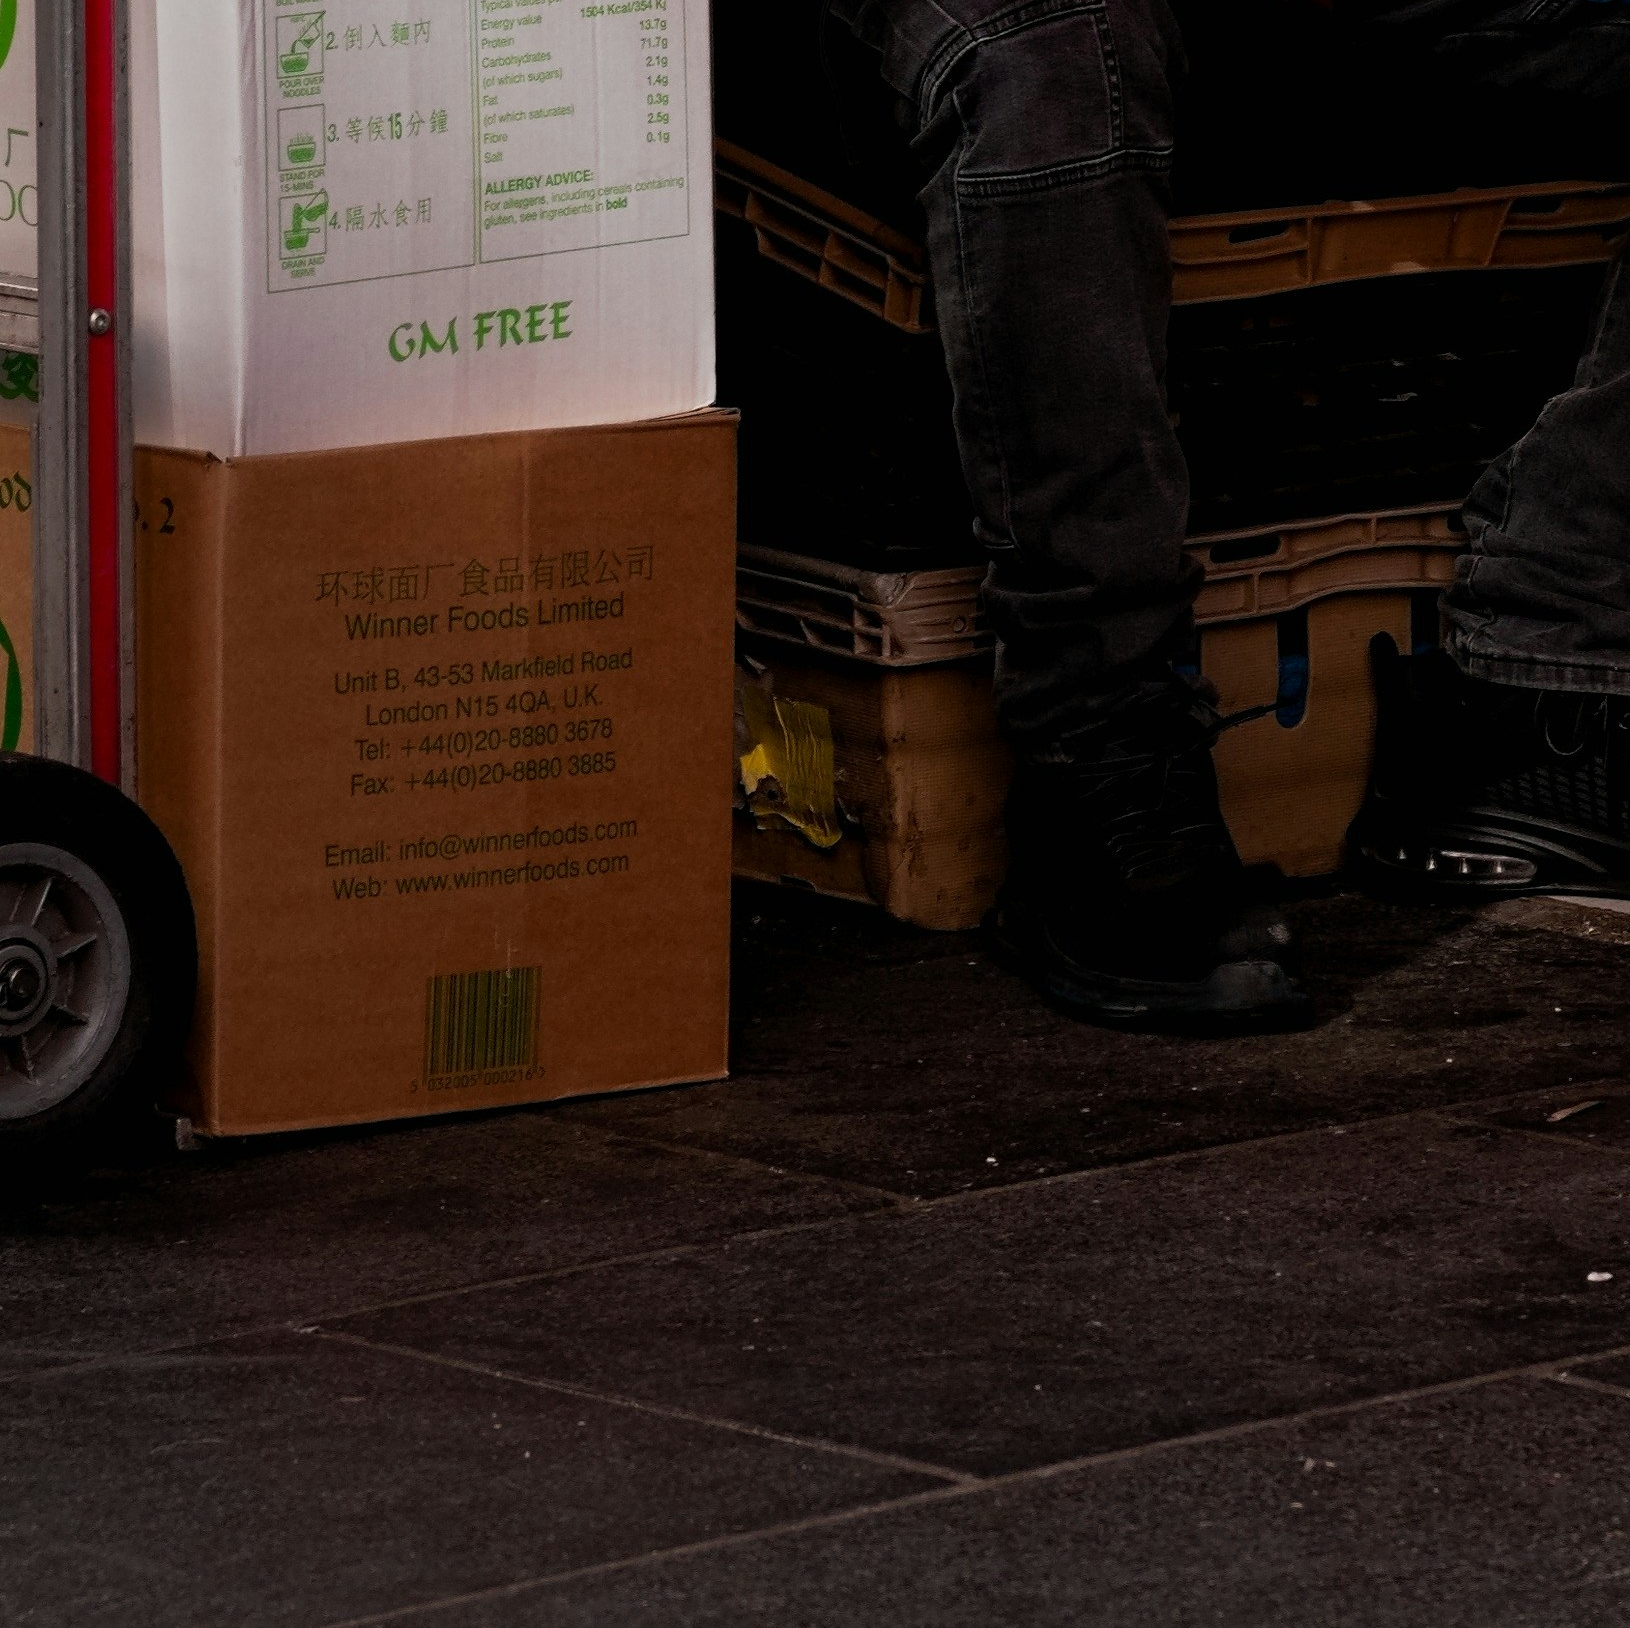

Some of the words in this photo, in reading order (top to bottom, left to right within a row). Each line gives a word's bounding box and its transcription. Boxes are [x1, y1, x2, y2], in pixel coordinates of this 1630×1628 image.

[481, 37, 515, 49] Protein
[639, 18, 667, 30] 13.7g
[481, 51, 551, 69] Carbohydrates
[640, 37, 668, 49] 71.7g
[484, 151, 503, 164] Salt
[646, 131, 671, 143] 0.1g
[485, 174, 543, 195] ALLERGY
[546, 169, 594, 187] ADVICE:
[329, 211, 341, 230] 4.
[387, 317, 460, 364] GM
[474, 298, 575, 351] FREE
[344, 612, 439, 640] Winner
[447, 602, 530, 633] Foods
[537, 591, 625, 625] Limited
[334, 671, 378, 695] Unit
[384, 667, 408, 693] B,
[413, 662, 475, 689] 43-53
[481, 653, 574, 683] Markfield
[581, 646, 634, 673] Road
[365, 699, 449, 727] London
[456, 694, 499, 719] N15
[505, 690, 557, 715] 4QA,
[563, 683, 604, 709] U.K.
[354, 738, 392, 762] Tel:
[401, 723, 559, 760] +44(0)20-8880
[565, 717, 614, 742] 3678
[350, 773, 395, 797] Fax:
[404, 756, 563, 793] +44(0)20-8880
[567, 750, 617, 777] 3885
[324, 840, 392, 868] Email:
[399, 818, 639, 862] info@winnerfoods.com
[331, 875, 388, 901] Web:
